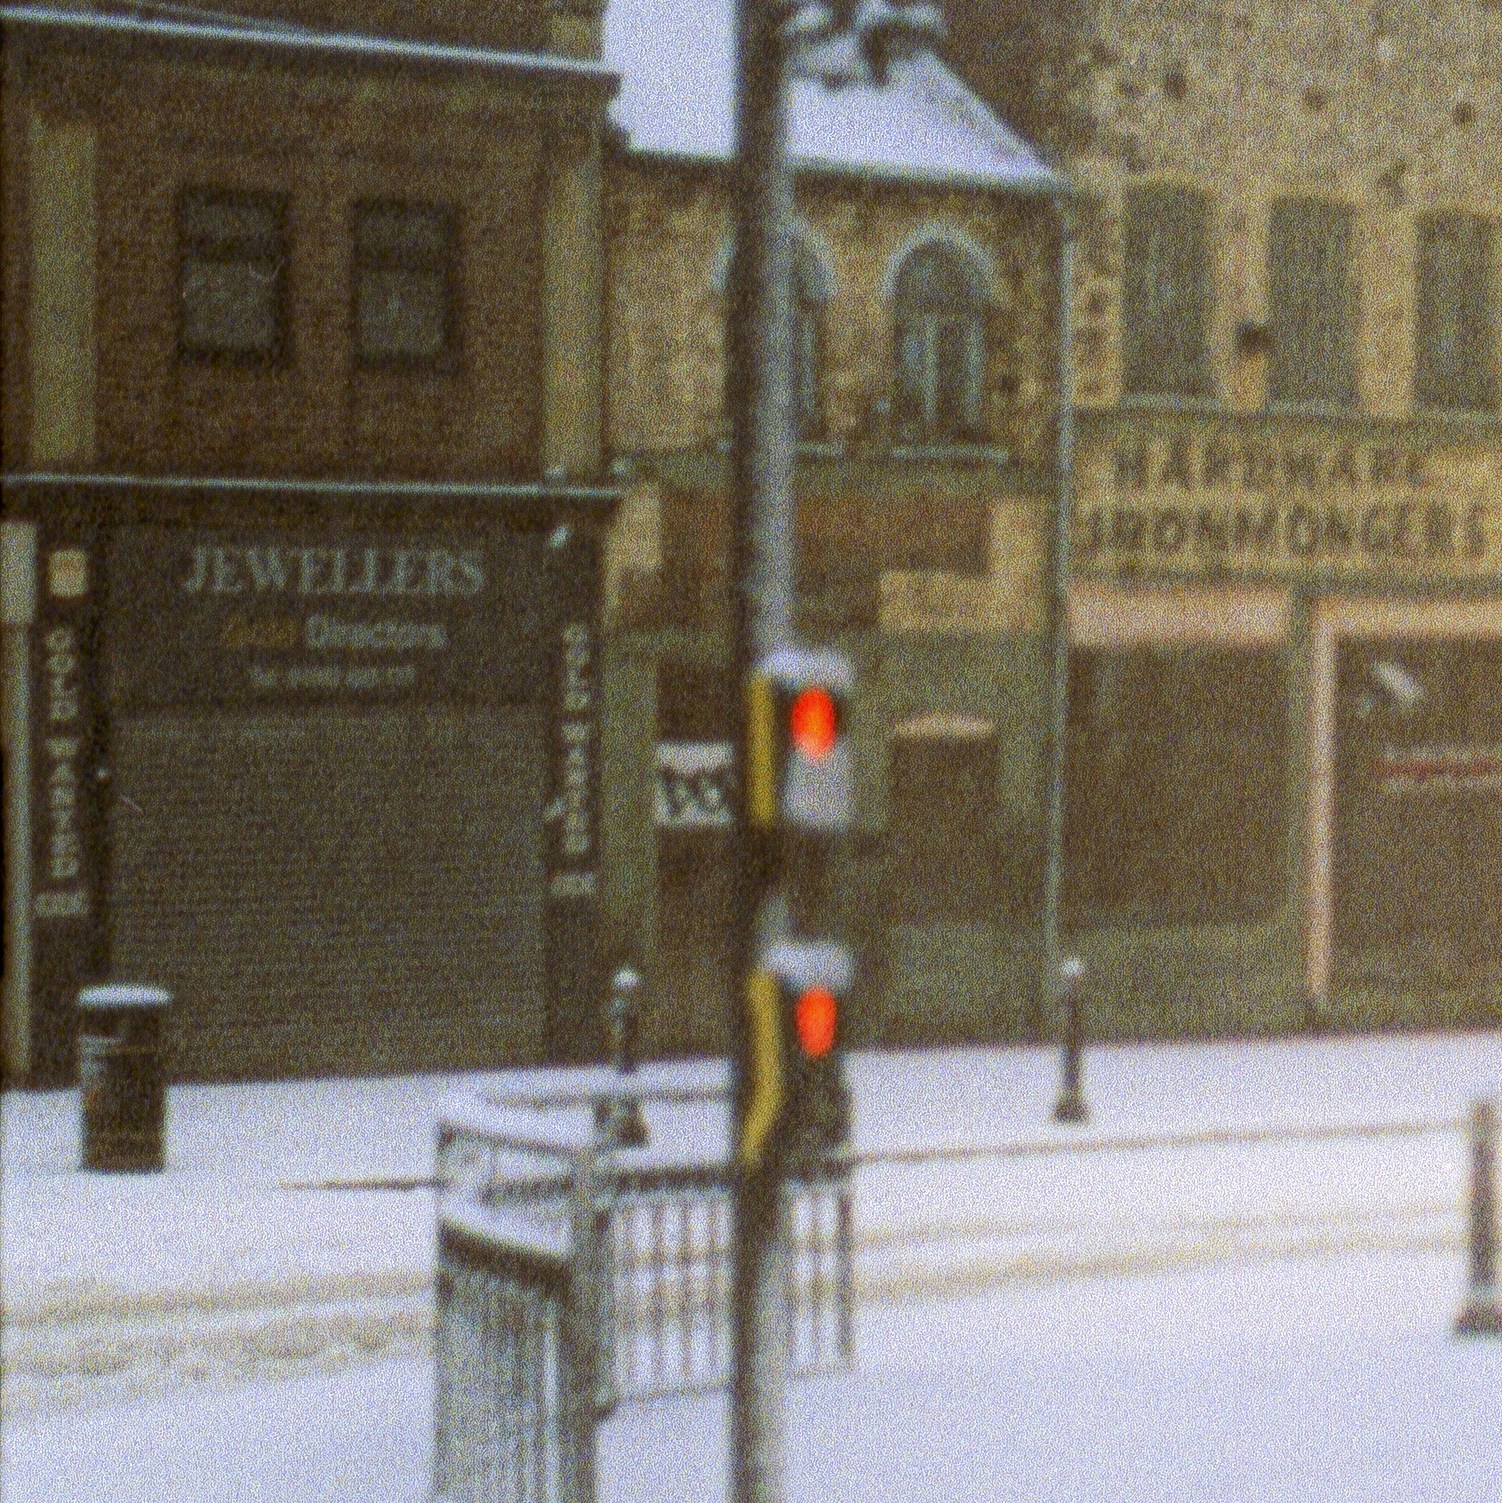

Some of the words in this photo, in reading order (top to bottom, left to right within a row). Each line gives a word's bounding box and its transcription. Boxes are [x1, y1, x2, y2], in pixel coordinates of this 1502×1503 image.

[1112, 436, 1427, 489] HARDWARE
[1084, 500, 1488, 560] IRONMONGERS
[182, 544, 487, 595] JEWELLERS
[45, 626, 79, 721] GOLD
[46, 737, 80, 879] WANTED
